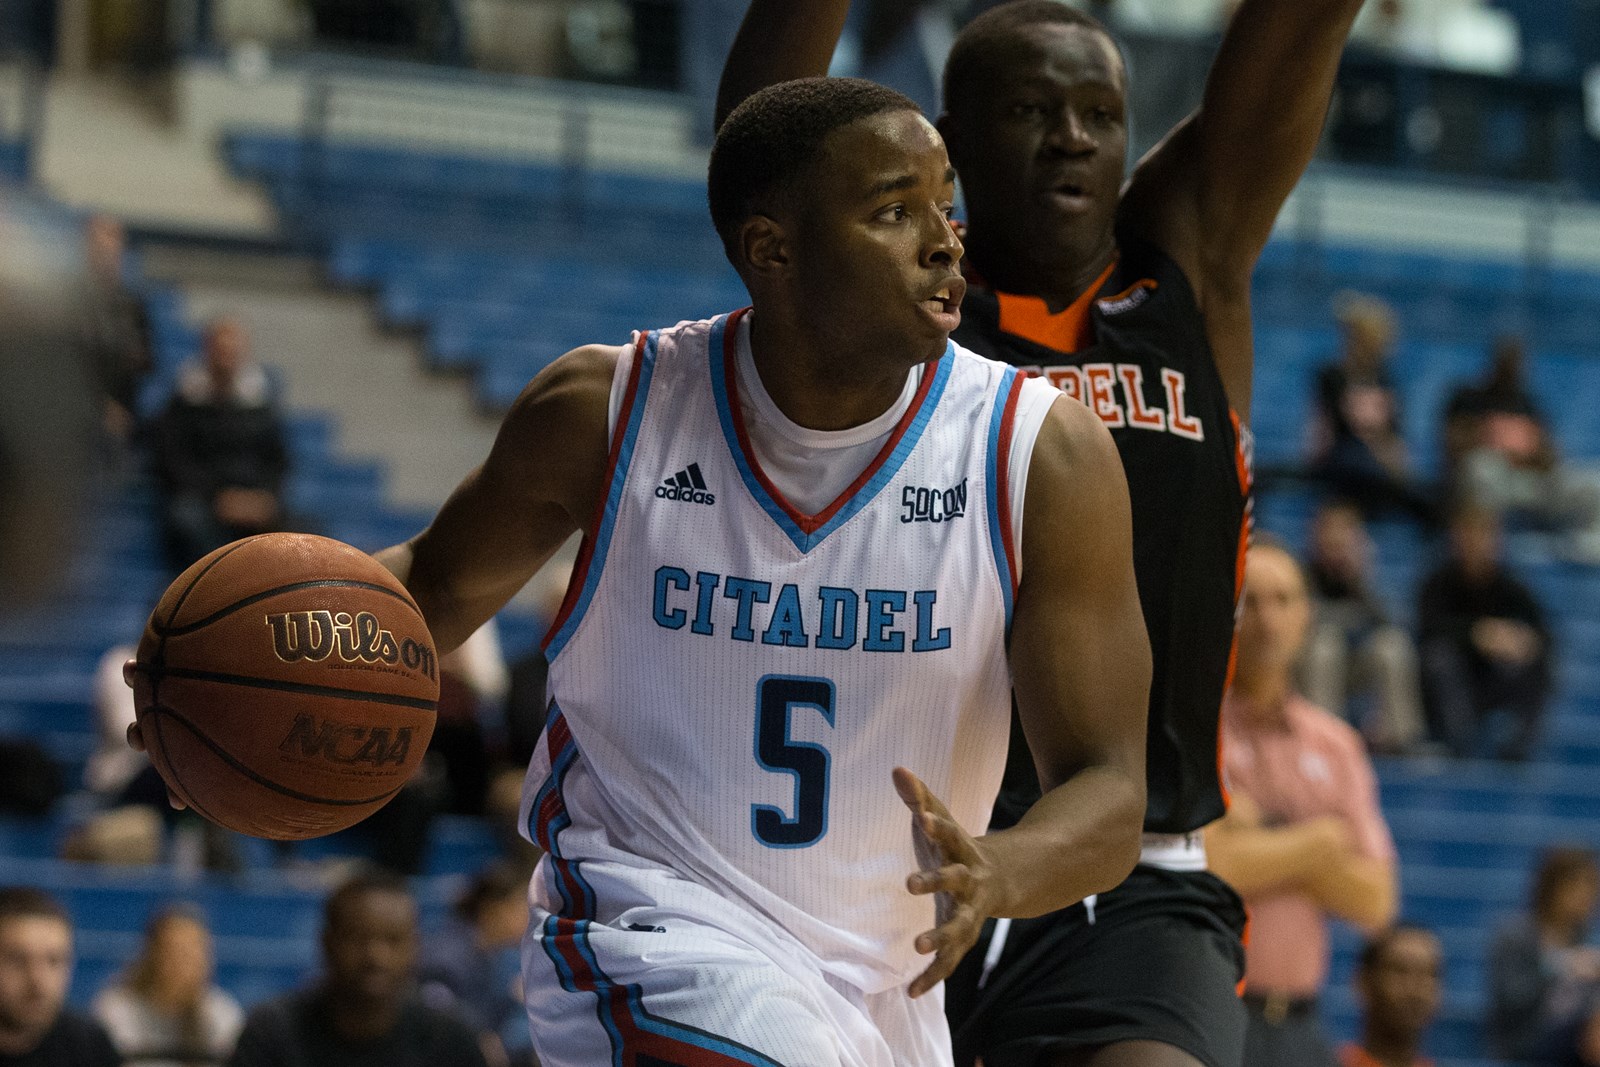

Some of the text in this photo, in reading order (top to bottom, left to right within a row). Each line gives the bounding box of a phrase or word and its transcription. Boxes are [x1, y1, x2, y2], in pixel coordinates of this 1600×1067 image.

[1020, 363, 1205, 442] ELL
[655, 484, 715, 506] adidas
[900, 477, 968, 523] SOCON
[652, 565, 952, 652] CITADEL
[265, 610, 436, 683] Wilson
[278, 712, 420, 768] NCAA
[750, 673, 836, 849] 5
